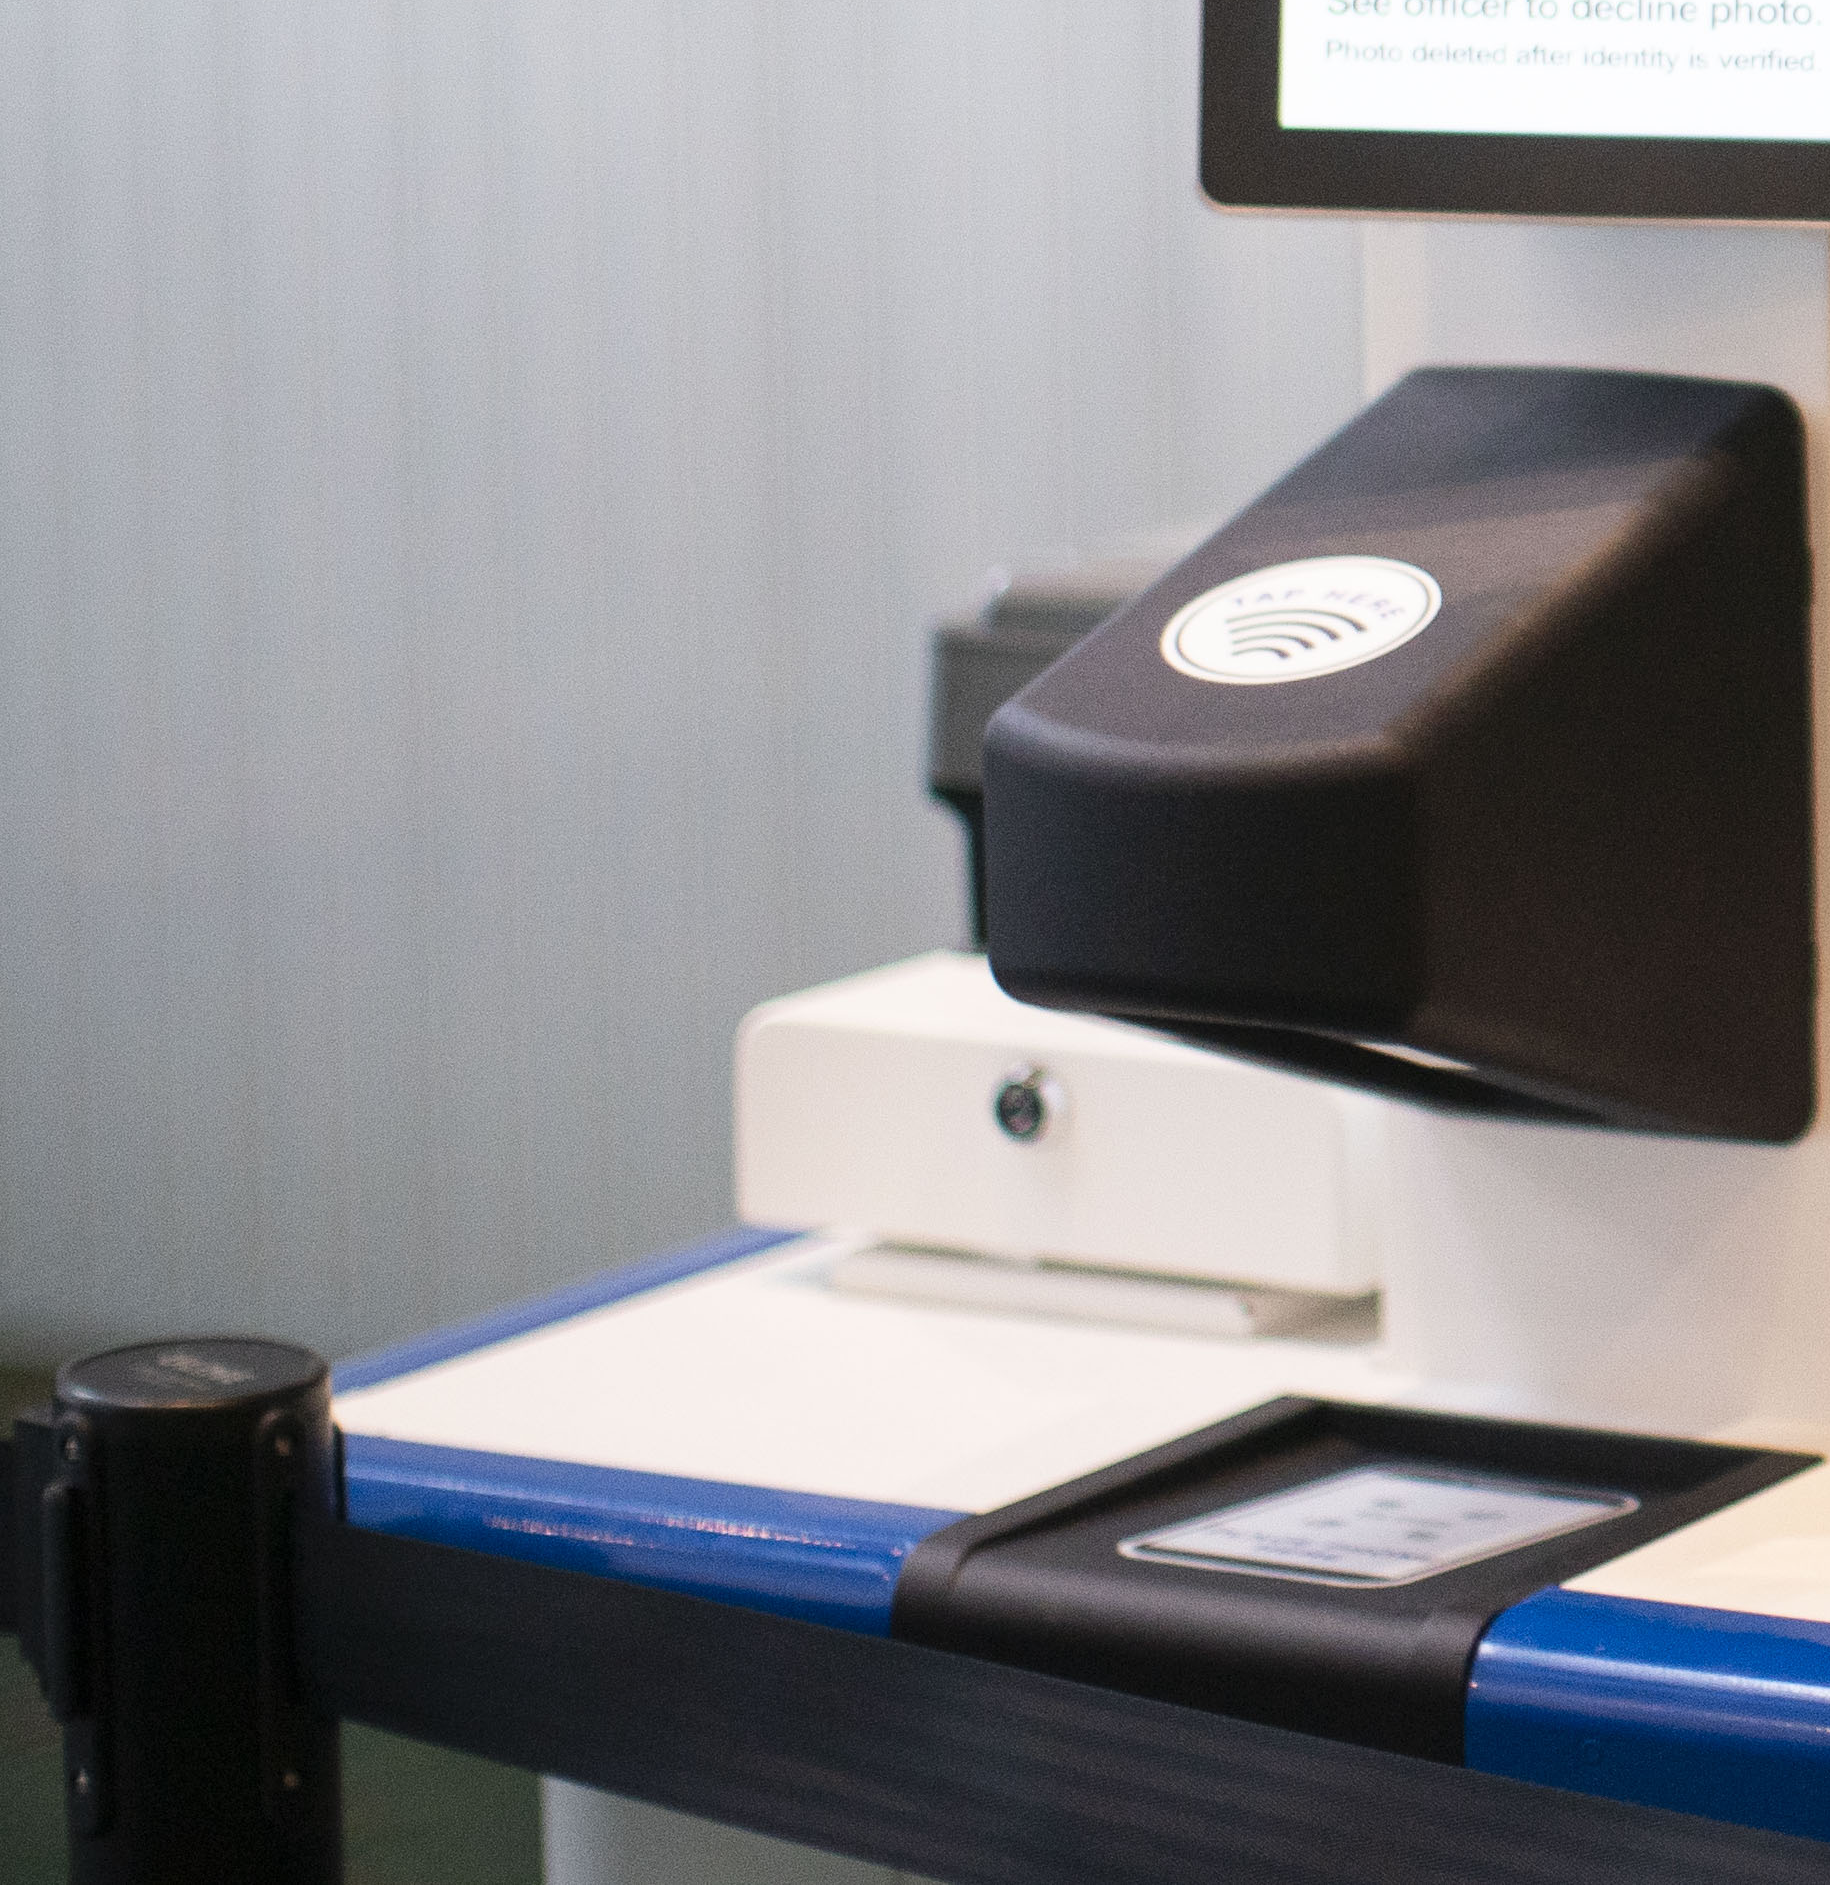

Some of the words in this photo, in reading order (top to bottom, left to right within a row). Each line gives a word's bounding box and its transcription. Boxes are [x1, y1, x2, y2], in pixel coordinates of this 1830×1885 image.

[1325, 38, 1402, 63] Photo
[1411, 41, 1507, 65] deleted
[1515, 44, 1573, 67] after
[1582, 46, 1679, 76] identity
[1688, 49, 1710, 70] is
[1324, 589, 1406, 620] HERE
